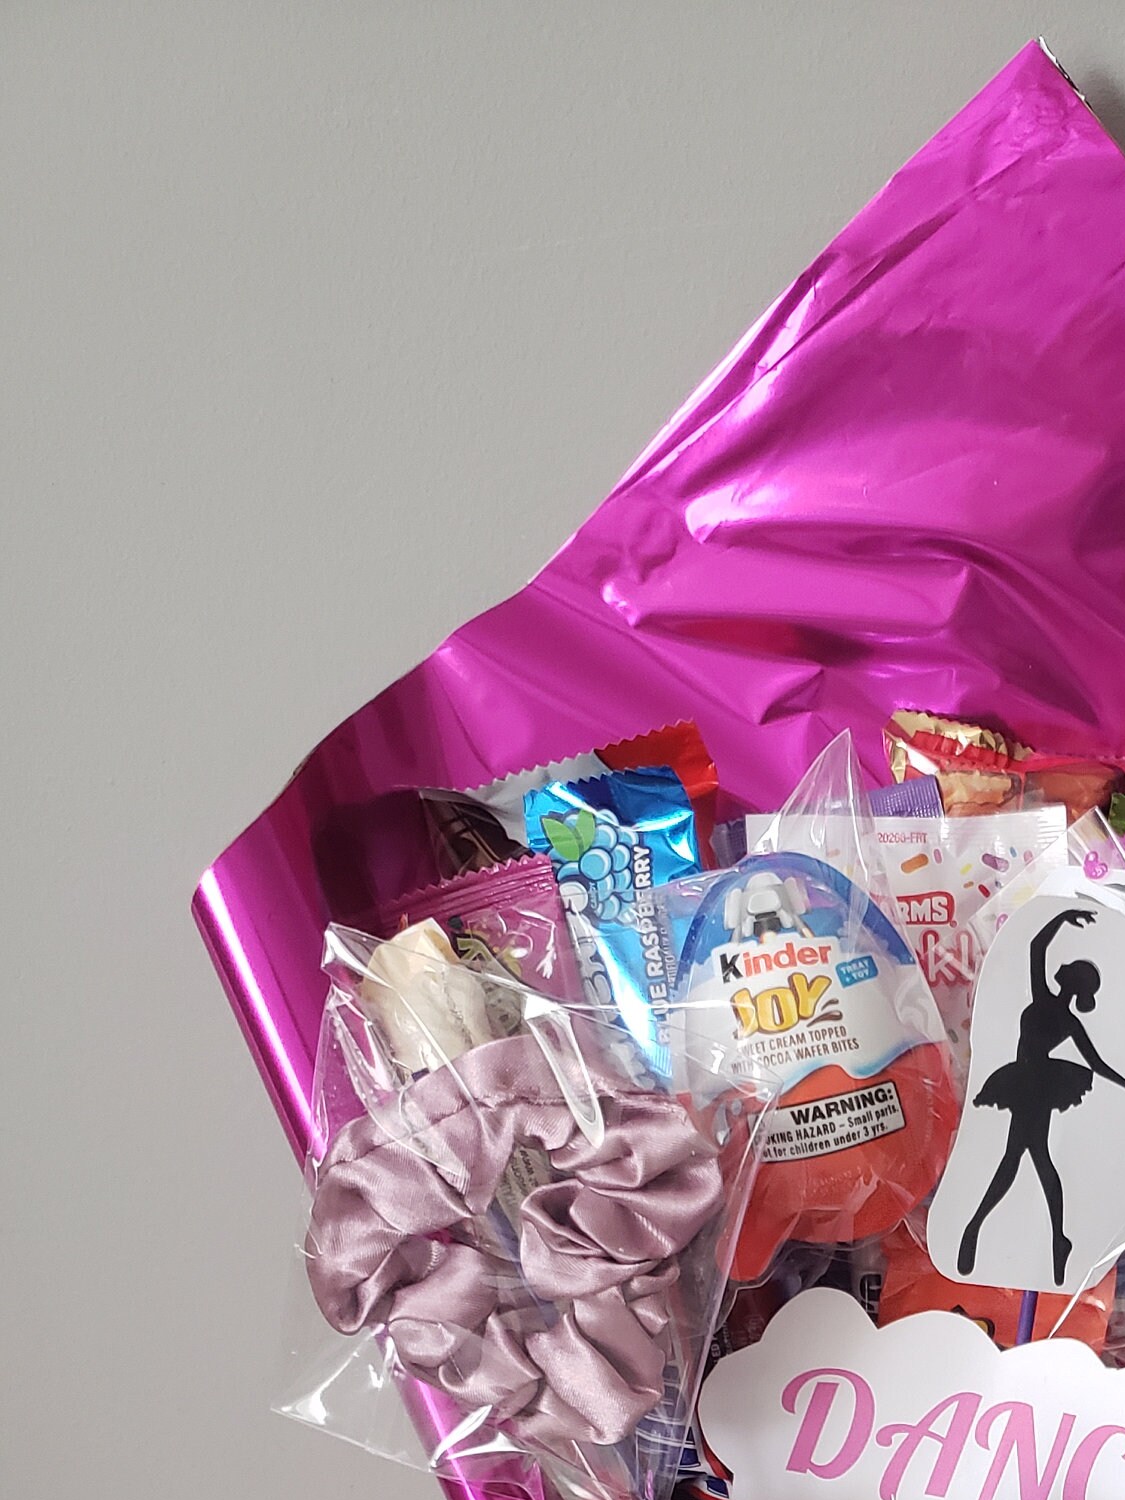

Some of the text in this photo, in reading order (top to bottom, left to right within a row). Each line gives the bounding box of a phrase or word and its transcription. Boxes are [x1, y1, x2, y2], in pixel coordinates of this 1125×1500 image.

[719, 942, 832, 984] Kinder
[731, 1060, 754, 1075] WITH
[795, 1042, 830, 1061] WAFER
[831, 1037, 861, 1054] BITES
[741, 1025, 847, 1057] WEET CREAM TOPPED
[790, 1087, 894, 1126] WARNING:
[796, 1121, 836, 1141] HAZARD
[848, 1109, 873, 1128] Small
[875, 1103, 899, 1120] parts.
[762, 1122, 888, 1159] ot for children under 3 yrs.
